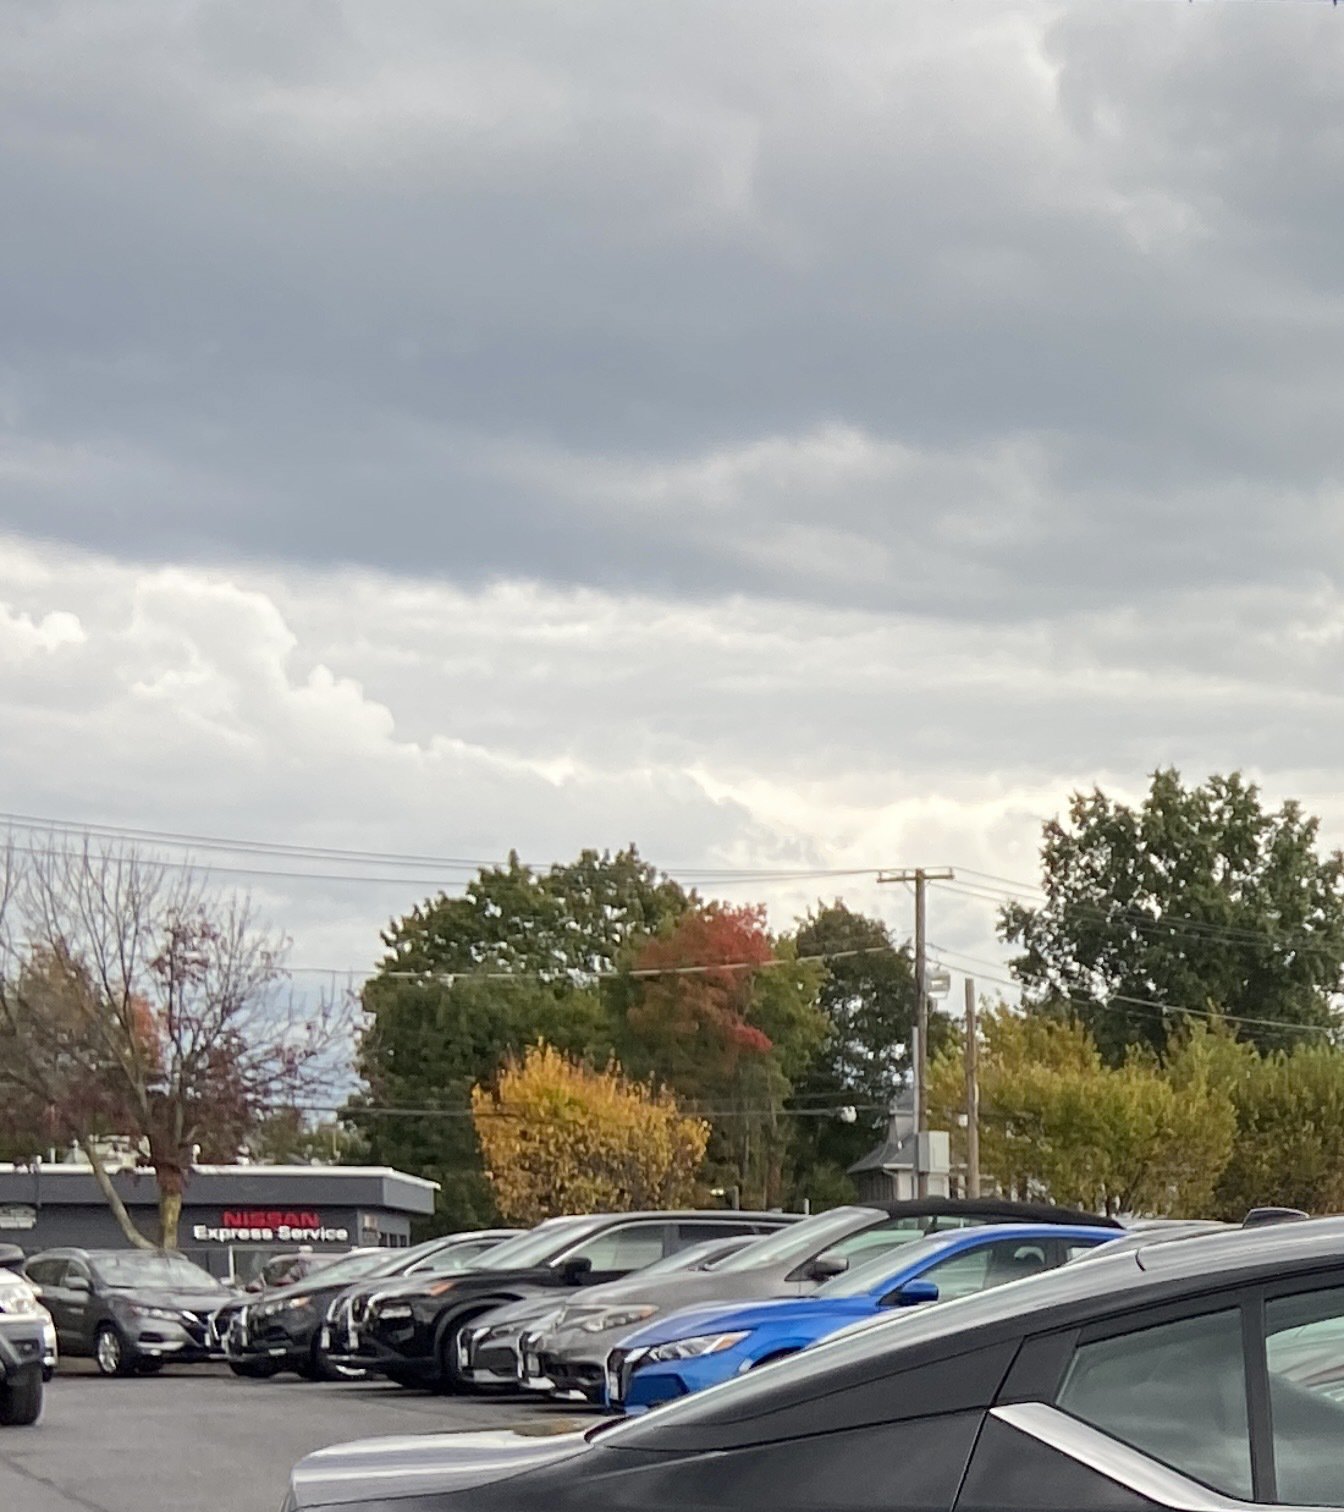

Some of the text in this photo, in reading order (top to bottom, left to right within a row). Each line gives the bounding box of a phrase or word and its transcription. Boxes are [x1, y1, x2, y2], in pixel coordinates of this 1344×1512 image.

[222, 1211, 321, 1228] NISSAN
[194, 1224, 349, 1242] Express Service
